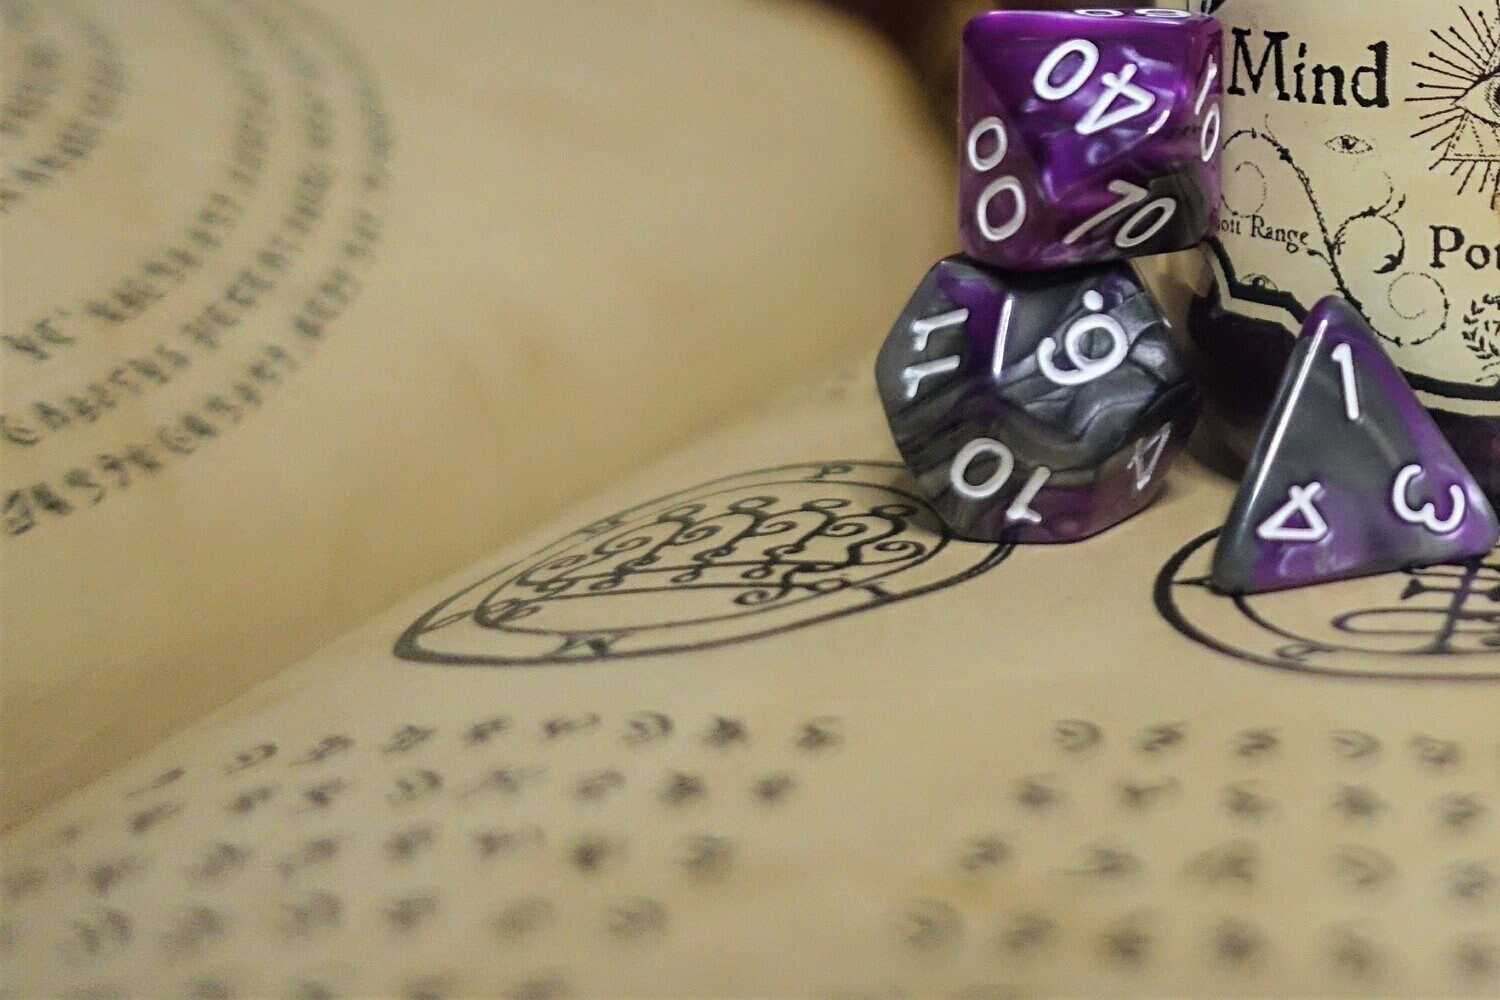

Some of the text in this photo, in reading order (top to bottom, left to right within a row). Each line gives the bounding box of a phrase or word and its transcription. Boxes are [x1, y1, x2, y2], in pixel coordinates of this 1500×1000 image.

[1226, 27, 1391, 108] Mind
[1250, 213, 1310, 255] Range
[1331, 341, 1361, 421] 1
[1256, 480, 1328, 541] 4
[1391, 463, 1466, 533] 3
